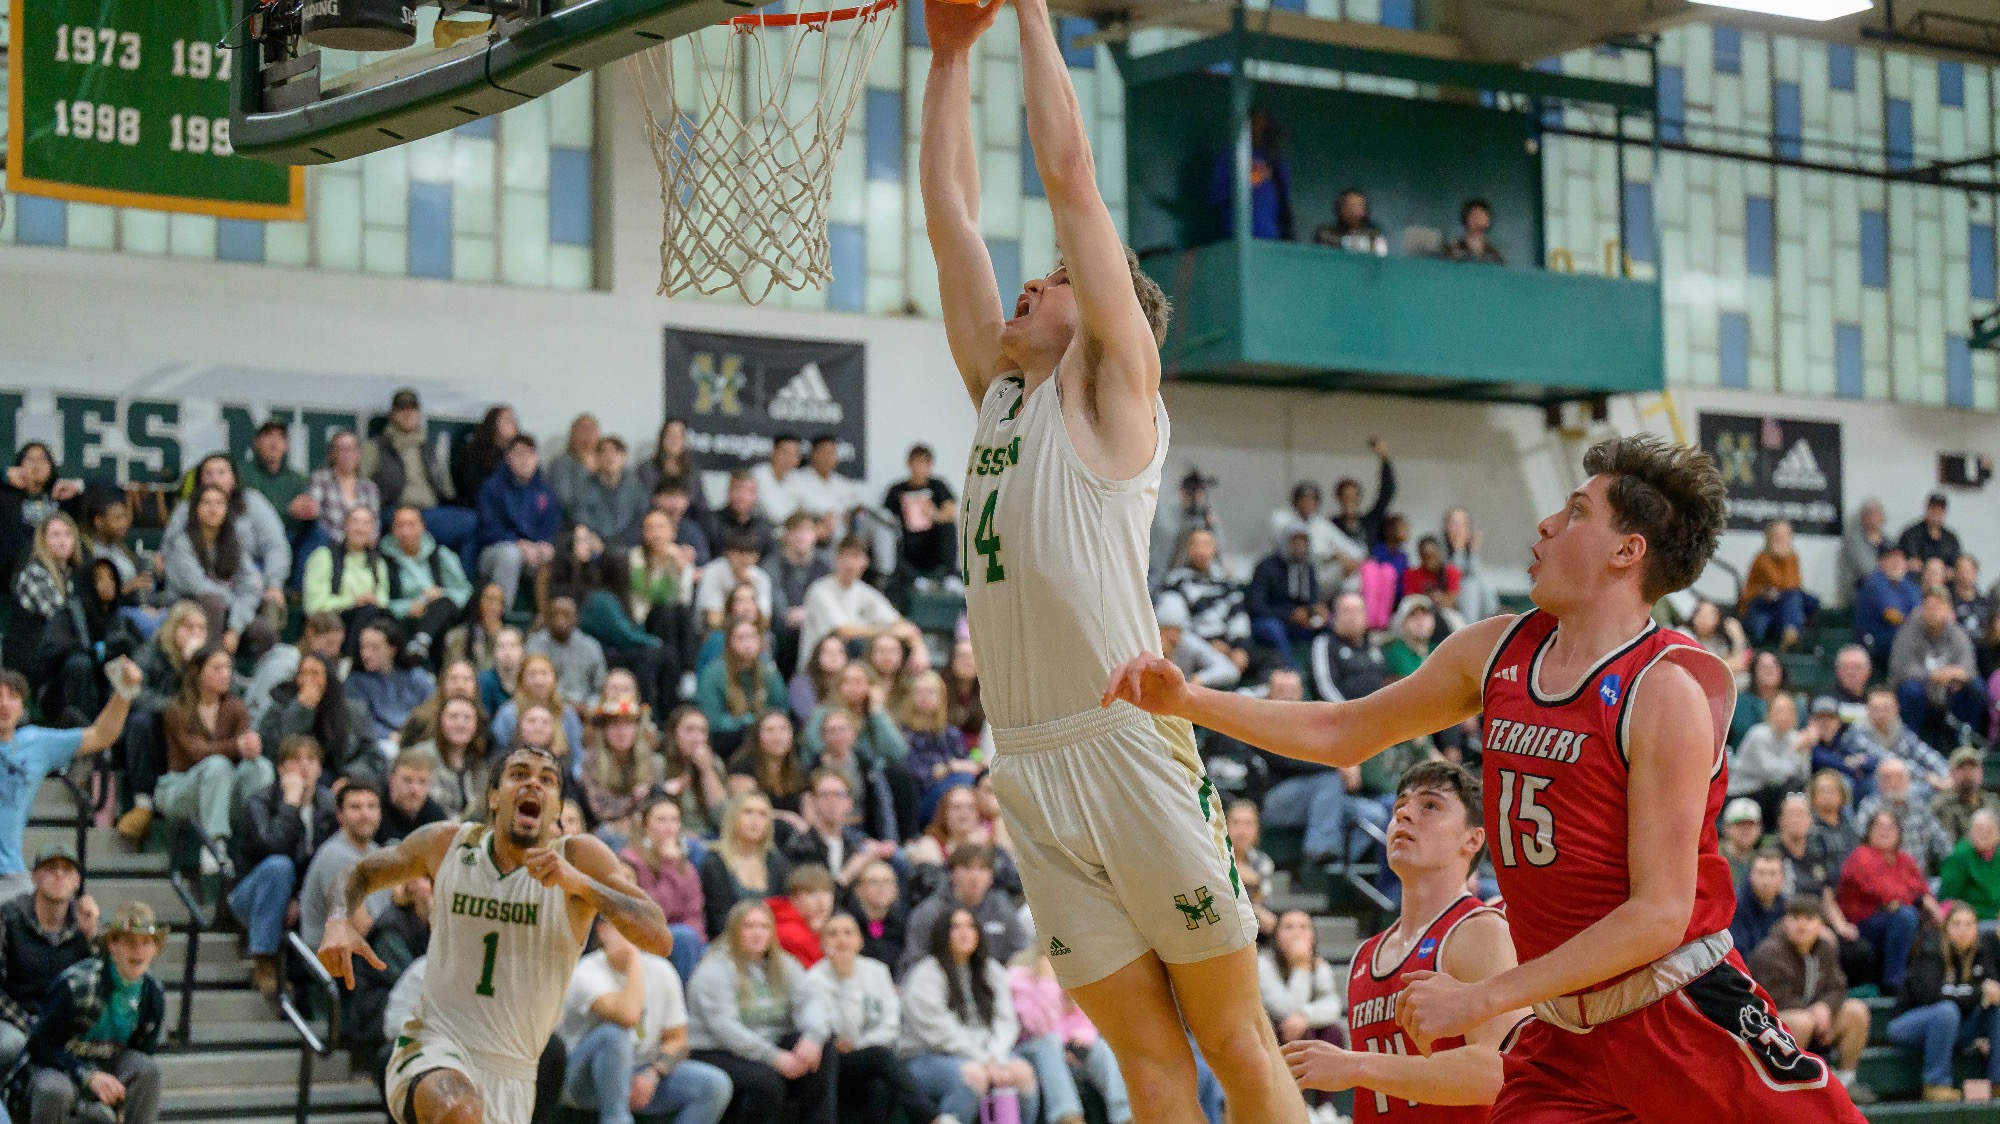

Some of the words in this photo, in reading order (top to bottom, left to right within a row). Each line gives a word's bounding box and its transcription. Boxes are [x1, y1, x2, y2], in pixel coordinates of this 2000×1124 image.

[54, 23, 141, 70] 1973
[171, 38, 233, 81] 197
[54, 99, 141, 146] 1998
[169, 113, 235, 157] 199
[1486, 718, 1592, 764] TERRIERS
[1498, 768, 1559, 868] 15
[452, 892, 539, 926] HUSSON
[475, 931, 499, 998] 1
